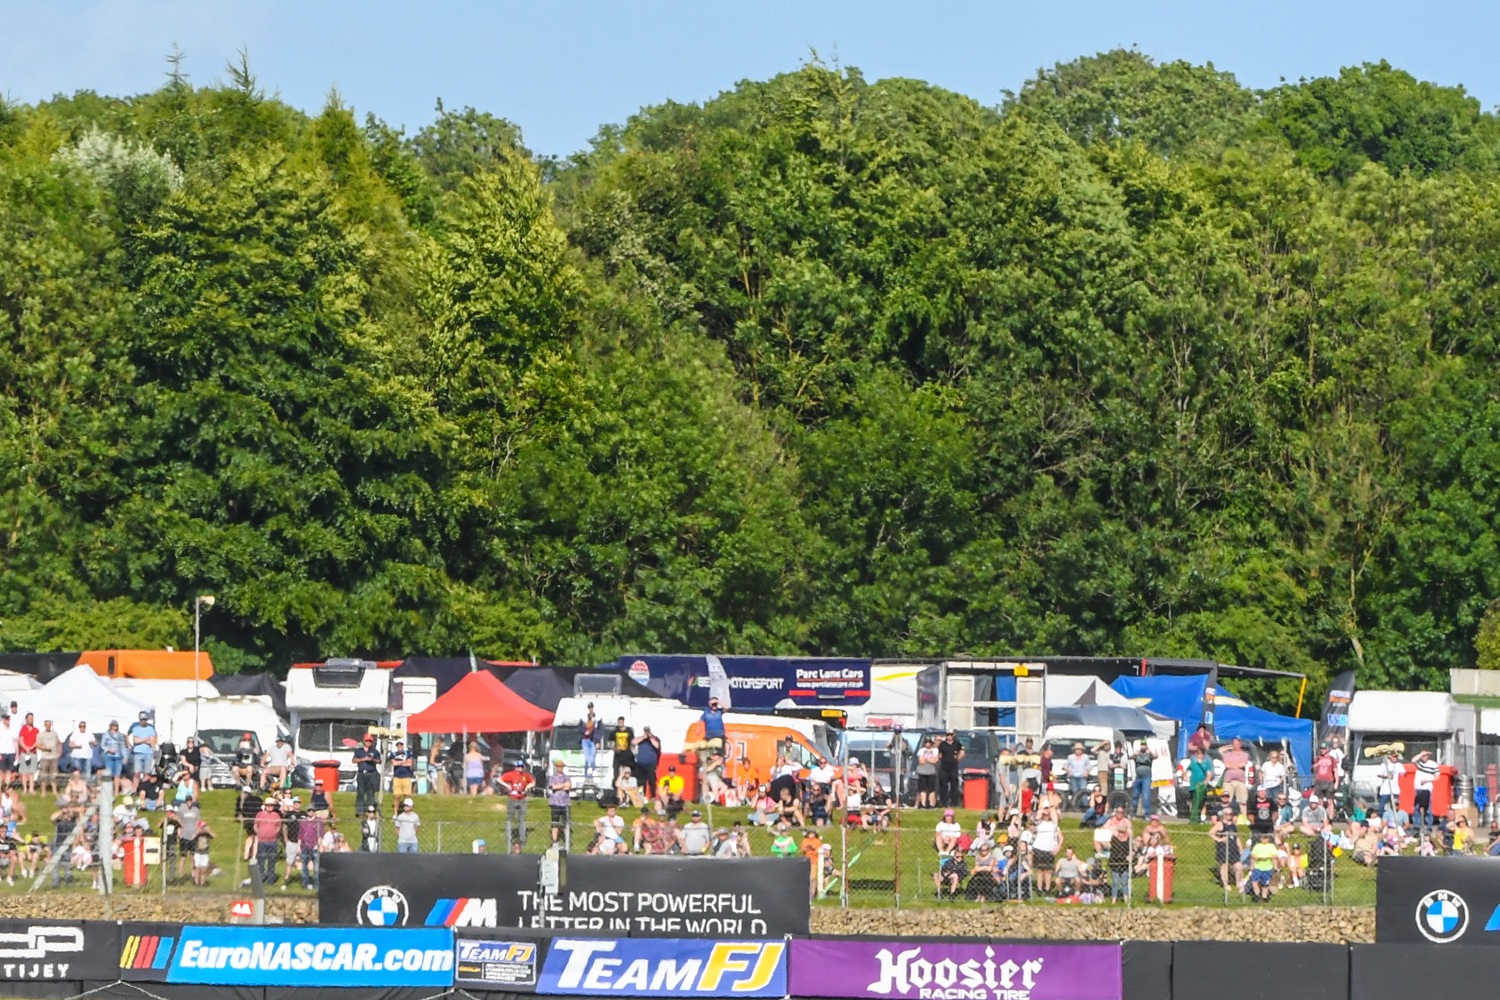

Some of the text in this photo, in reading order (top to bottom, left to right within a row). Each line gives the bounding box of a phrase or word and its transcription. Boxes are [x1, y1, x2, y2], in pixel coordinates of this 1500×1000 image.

[796, 668, 818, 679] Parc
[517, 890, 762, 915] THE MOST POWERFUL
[180, 939, 452, 972] EuroNASCAR.com
[3, 963, 70, 979] TIJEY
[866, 945, 1044, 994] Hoosier
[919, 988, 1030, 1000] RACING TIRE
